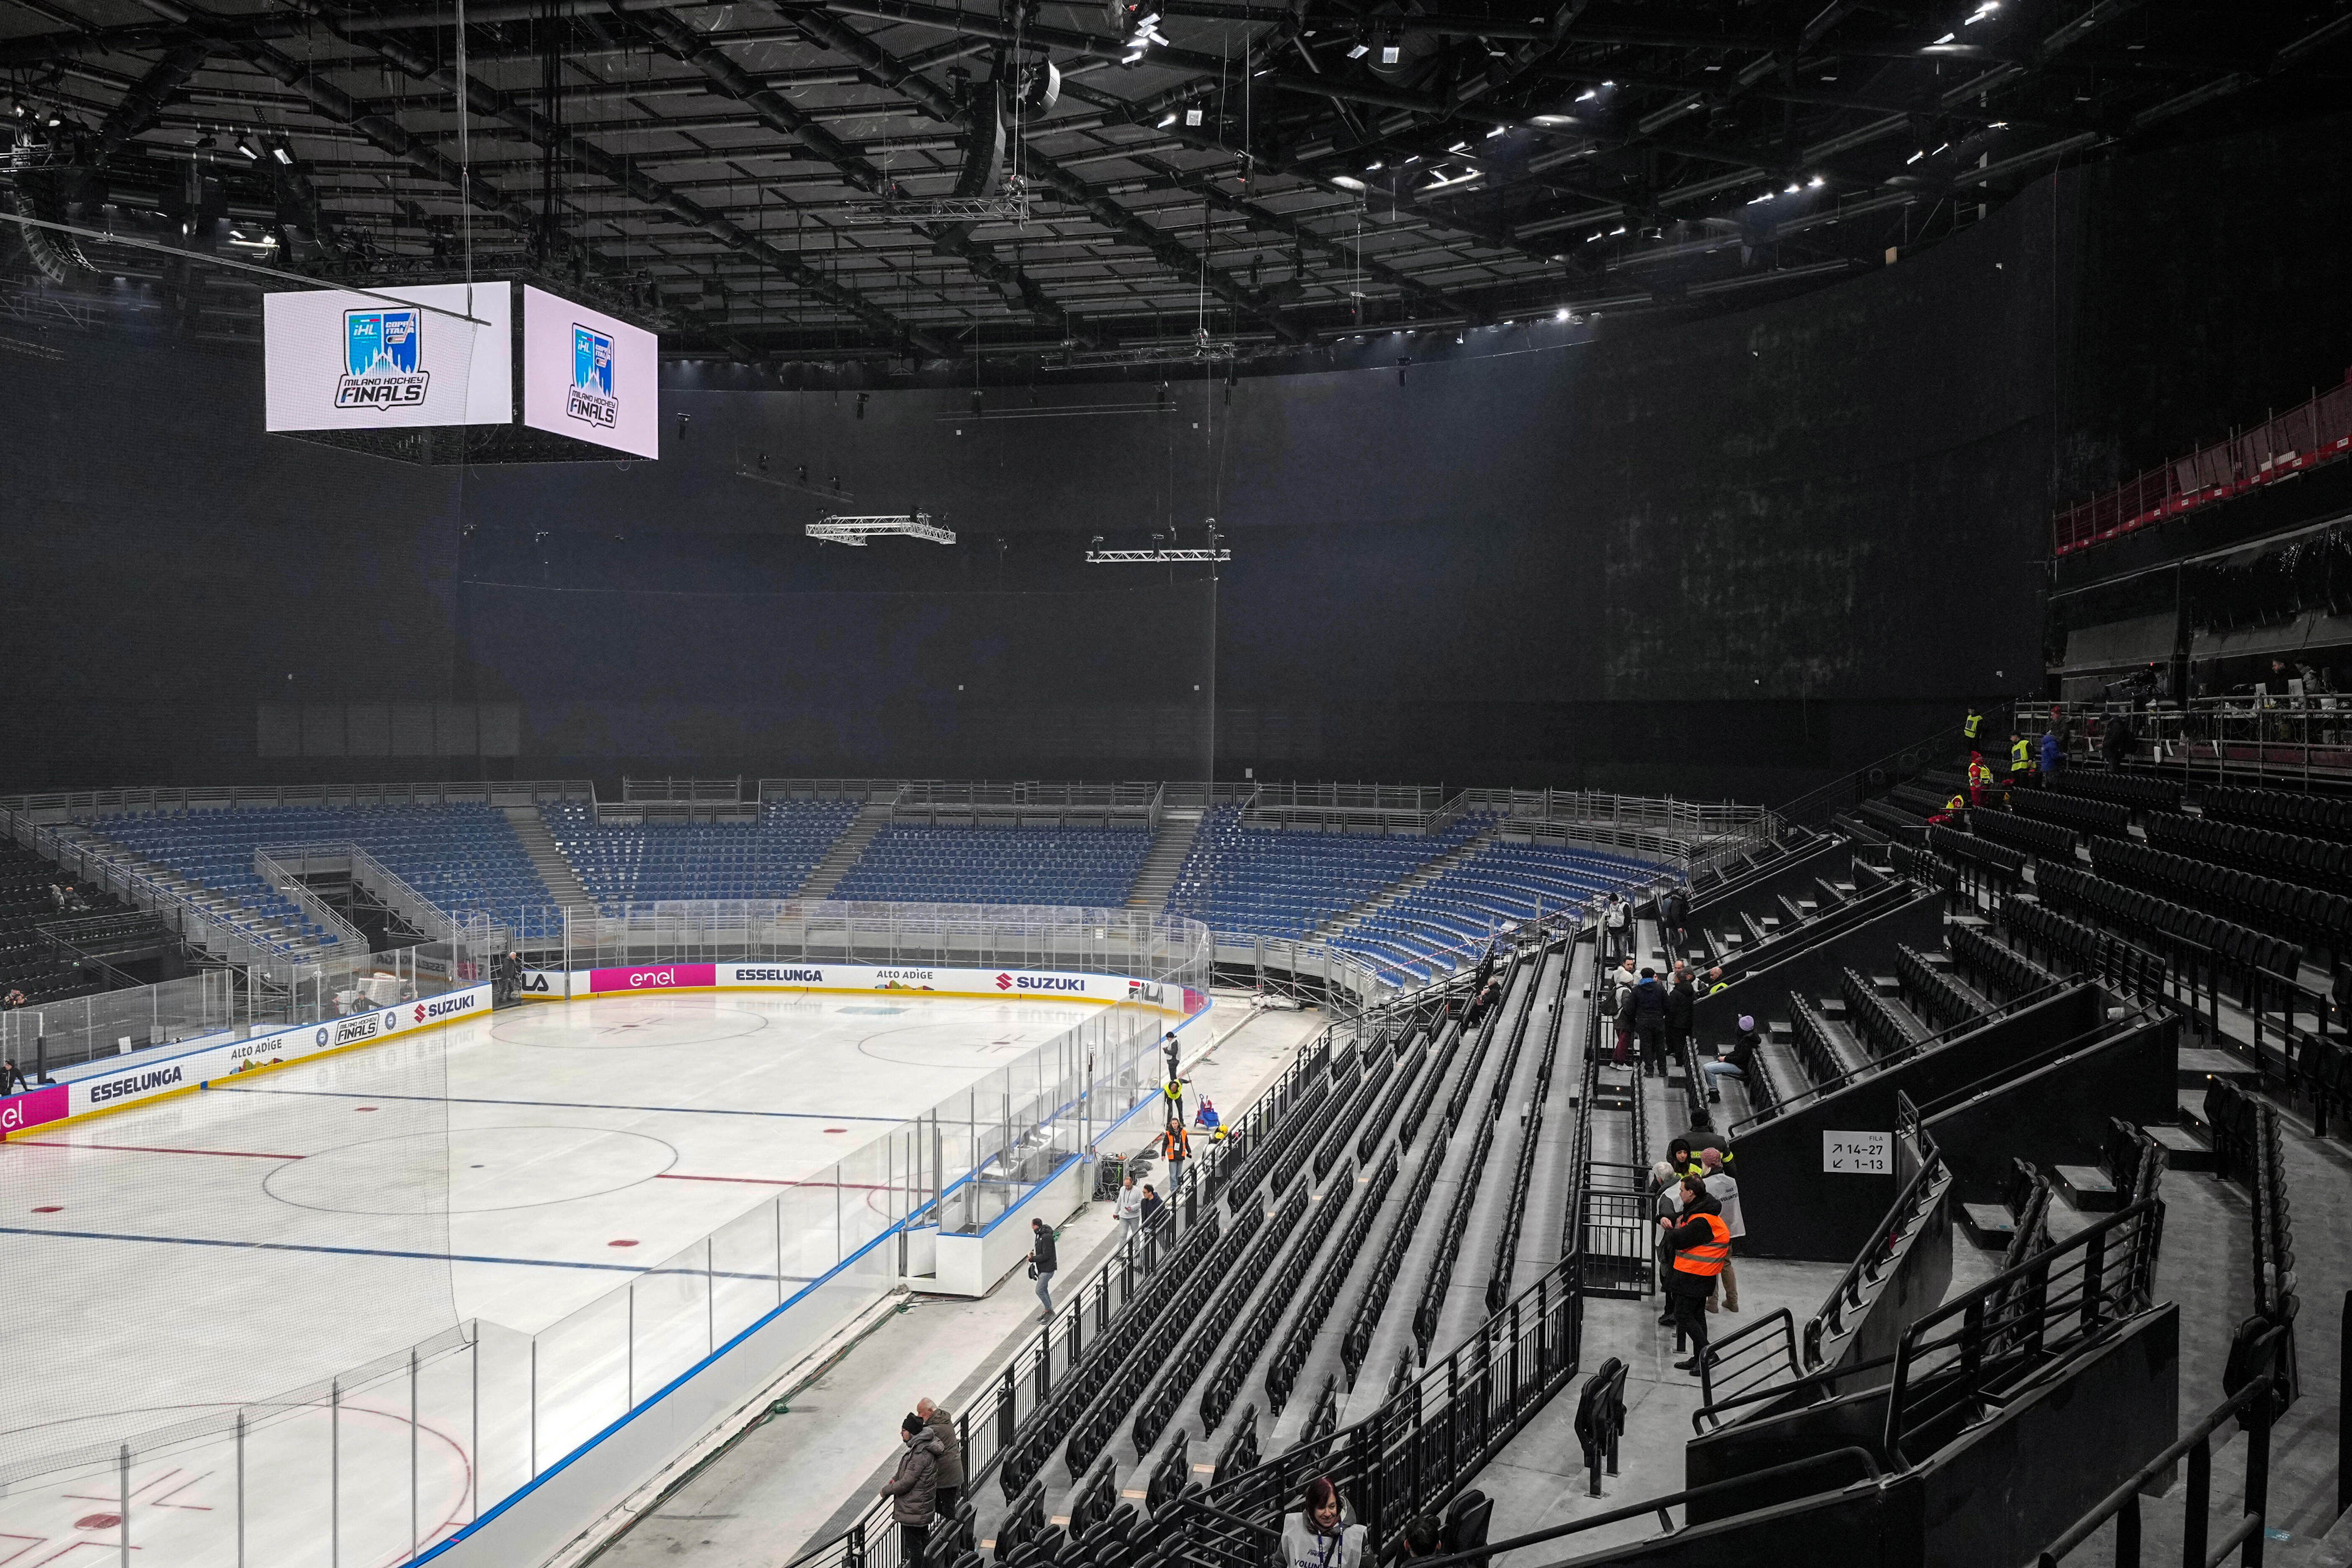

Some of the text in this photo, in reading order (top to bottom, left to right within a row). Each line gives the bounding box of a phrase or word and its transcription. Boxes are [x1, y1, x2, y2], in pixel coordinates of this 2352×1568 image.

[341, 385, 422, 403] FINALS
[572, 390, 615, 408] MILANO HOCKEY
[570, 398, 615, 423] FINALS
[630, 967, 676, 986] enel
[736, 969, 823, 981] ESSELUNGA
[1017, 976, 1085, 991] SUZUKI
[428, 995, 474, 1017] SUZUKI
[338, 1023, 376, 1041] FINALS
[339, 1022, 358, 1030] MILANO
[358, 1017, 377, 1026] HOCKEY
[91, 1066, 182, 1103] ESSELUNGA
[0, 1100, 23, 1128] el
[1847, 1145, 1883, 1155] 14-27
[1854, 1159, 1883, 1169] 1-13
